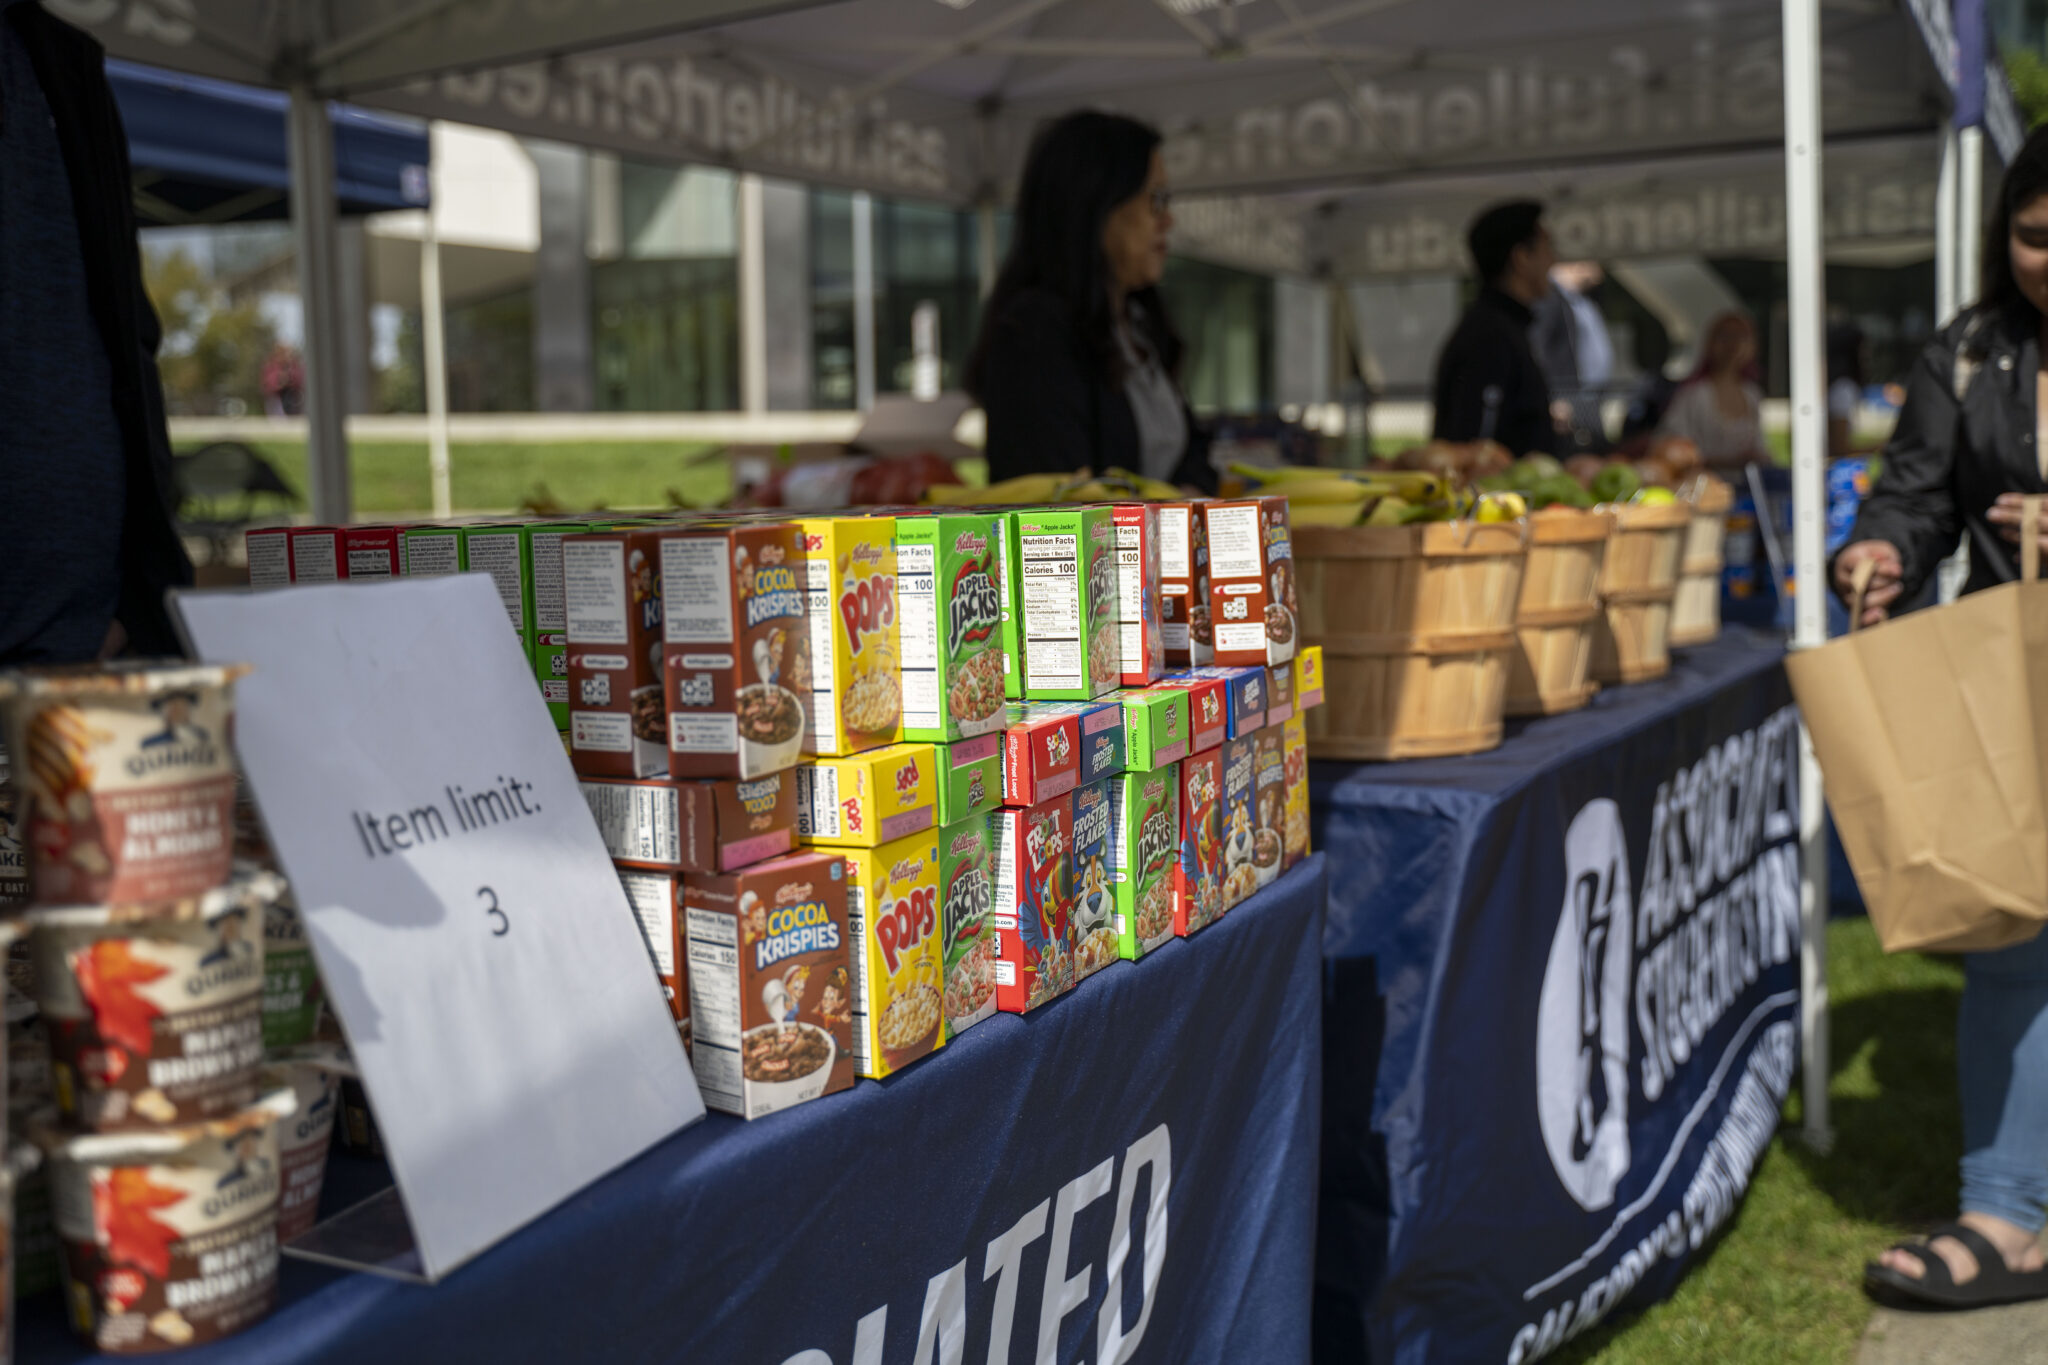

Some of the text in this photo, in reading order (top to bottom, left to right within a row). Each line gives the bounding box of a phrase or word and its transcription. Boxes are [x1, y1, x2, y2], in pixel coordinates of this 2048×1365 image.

[911, 548, 932, 556] Facts
[956, 532, 987, 556] Kellogg's
[1023, 537, 1053, 545] Nutrition
[1024, 563, 1076, 574] Calories 100
[1121, 553, 1139, 562] 100
[755, 568, 797, 596] COCOA
[915, 579, 933, 590] 100
[958, 574, 988, 600] APPLE
[747, 590, 804, 628] KRISPIES
[840, 575, 894, 656] POPS
[949, 589, 998, 659] JACKS
[1092, 743, 1114, 764] FROSTED
[1093, 756, 1112, 775] FLAKES
[896, 757, 919, 792] POPS
[1187, 761, 1214, 799] FROOT
[1225, 752, 1252, 787] FROSTED
[1227, 769, 1251, 799] FLAKES
[1078, 788, 1102, 810] Kellogg's
[1143, 778, 1165, 801] Kellogg's
[1190, 780, 1216, 816] LOOPS
[352, 774, 542, 859] Item limit:
[798, 812, 809, 834] 100
[841, 798, 862, 833] POPS
[1072, 800, 1109, 839] FROSTED
[1143, 811, 1165, 838] APPLE
[641, 836, 651, 858] 150
[950, 832, 981, 857] Kellogg's
[1026, 808, 1061, 857] FROOT
[1074, 817, 1107, 855] FLAKES
[1031, 832, 1063, 873] LOOPS
[1137, 822, 1171, 889] JACKS
[889, 858, 924, 885] Kellogg's
[951, 870, 980, 901] APPLE
[477, 885, 510, 938] 3
[688, 912, 716, 923] Nutrition
[768, 902, 830, 937] COCOA
[943, 881, 991, 962] JACKS
[850, 921, 864, 933] 00
[876, 885, 937, 975] POPS
[690, 947, 736, 964] Calories 150
[757, 922, 840, 970] KRISPIES
